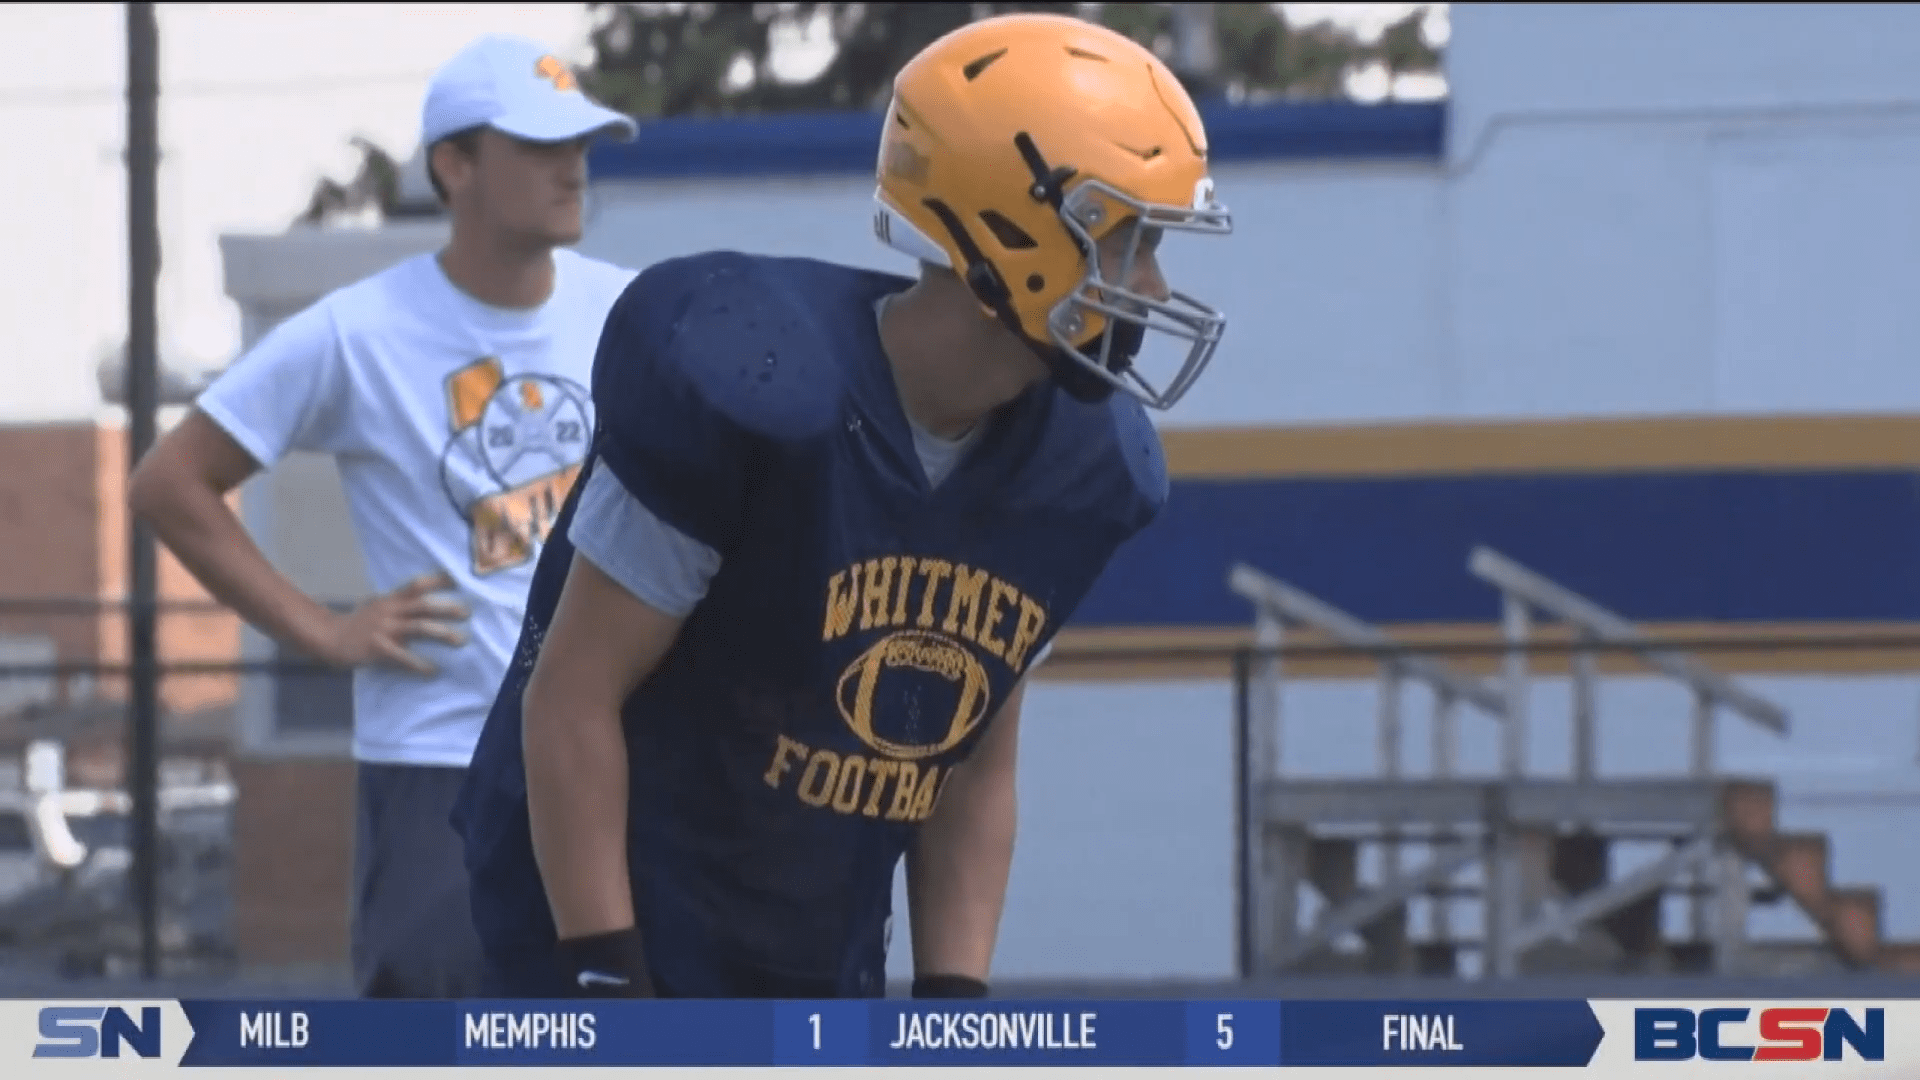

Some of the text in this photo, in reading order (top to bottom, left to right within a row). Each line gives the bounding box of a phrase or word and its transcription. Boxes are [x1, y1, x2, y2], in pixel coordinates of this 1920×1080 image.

[555, 420, 581, 444] 22
[822, 556, 1046, 674] WHITMER
[763, 733, 953, 821] FOOTBA
